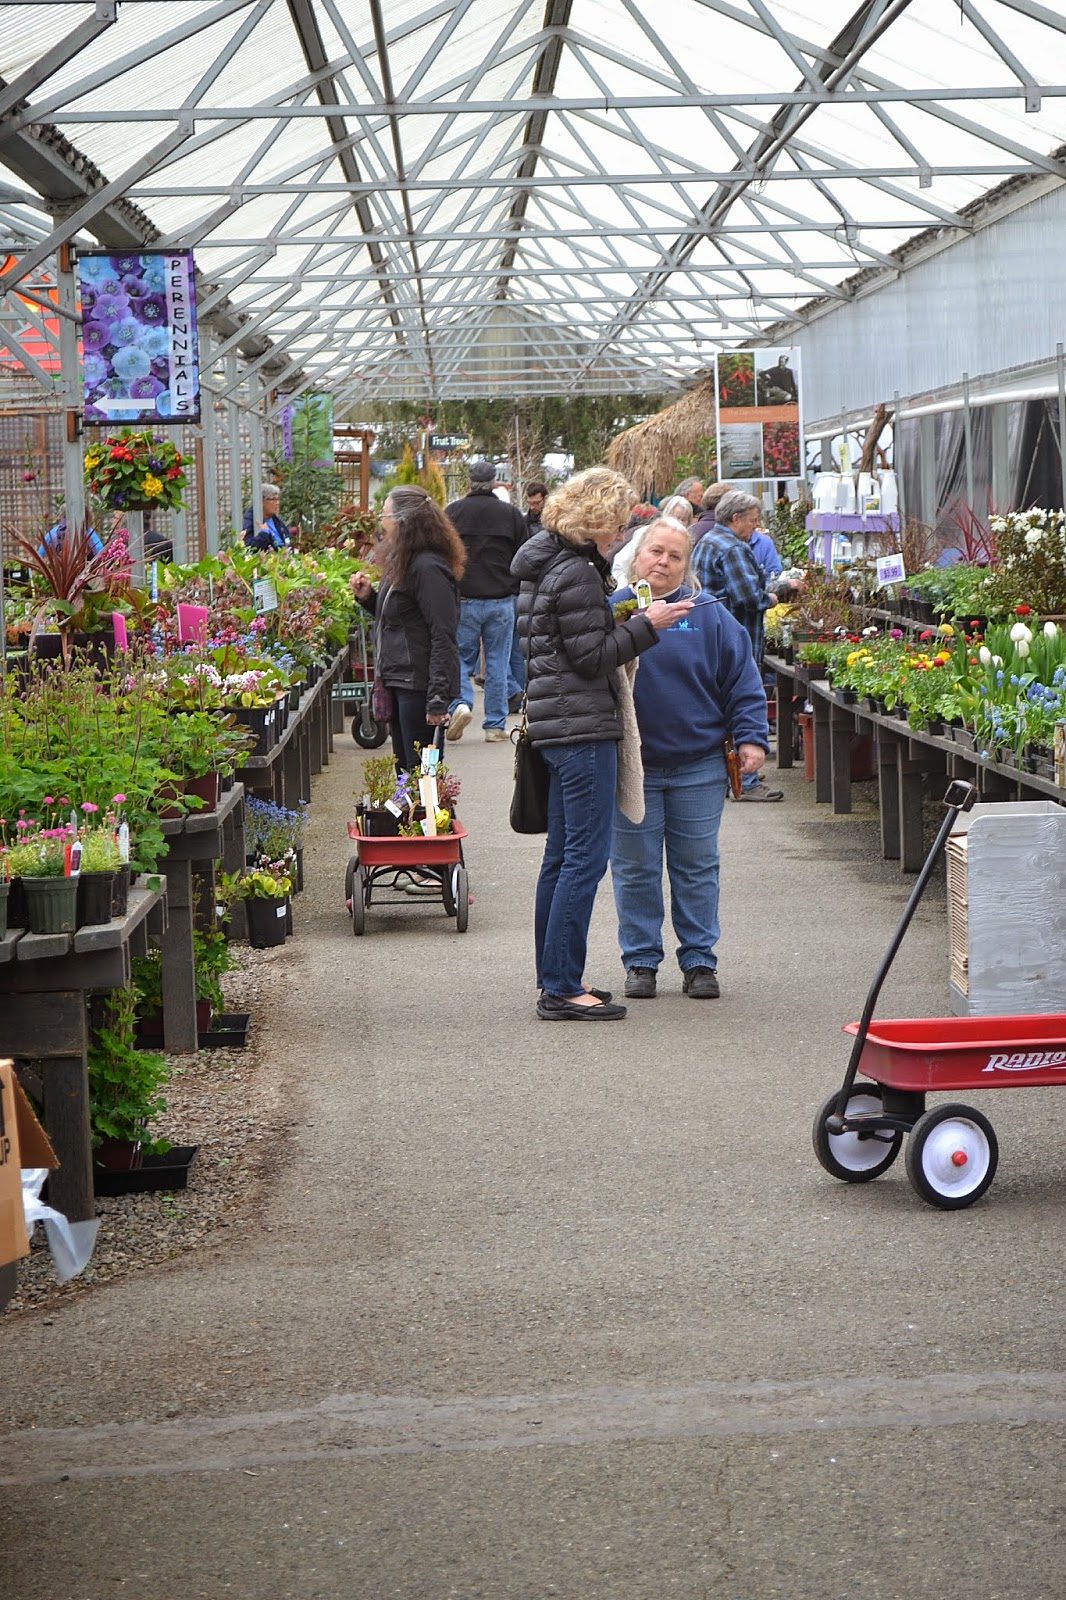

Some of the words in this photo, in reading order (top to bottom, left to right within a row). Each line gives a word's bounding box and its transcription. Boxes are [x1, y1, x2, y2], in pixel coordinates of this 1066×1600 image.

[171, 260, 189, 411] PERENNIALS
[432, 436, 449, 446] Fruit
[450, 436, 469, 446] Trees
